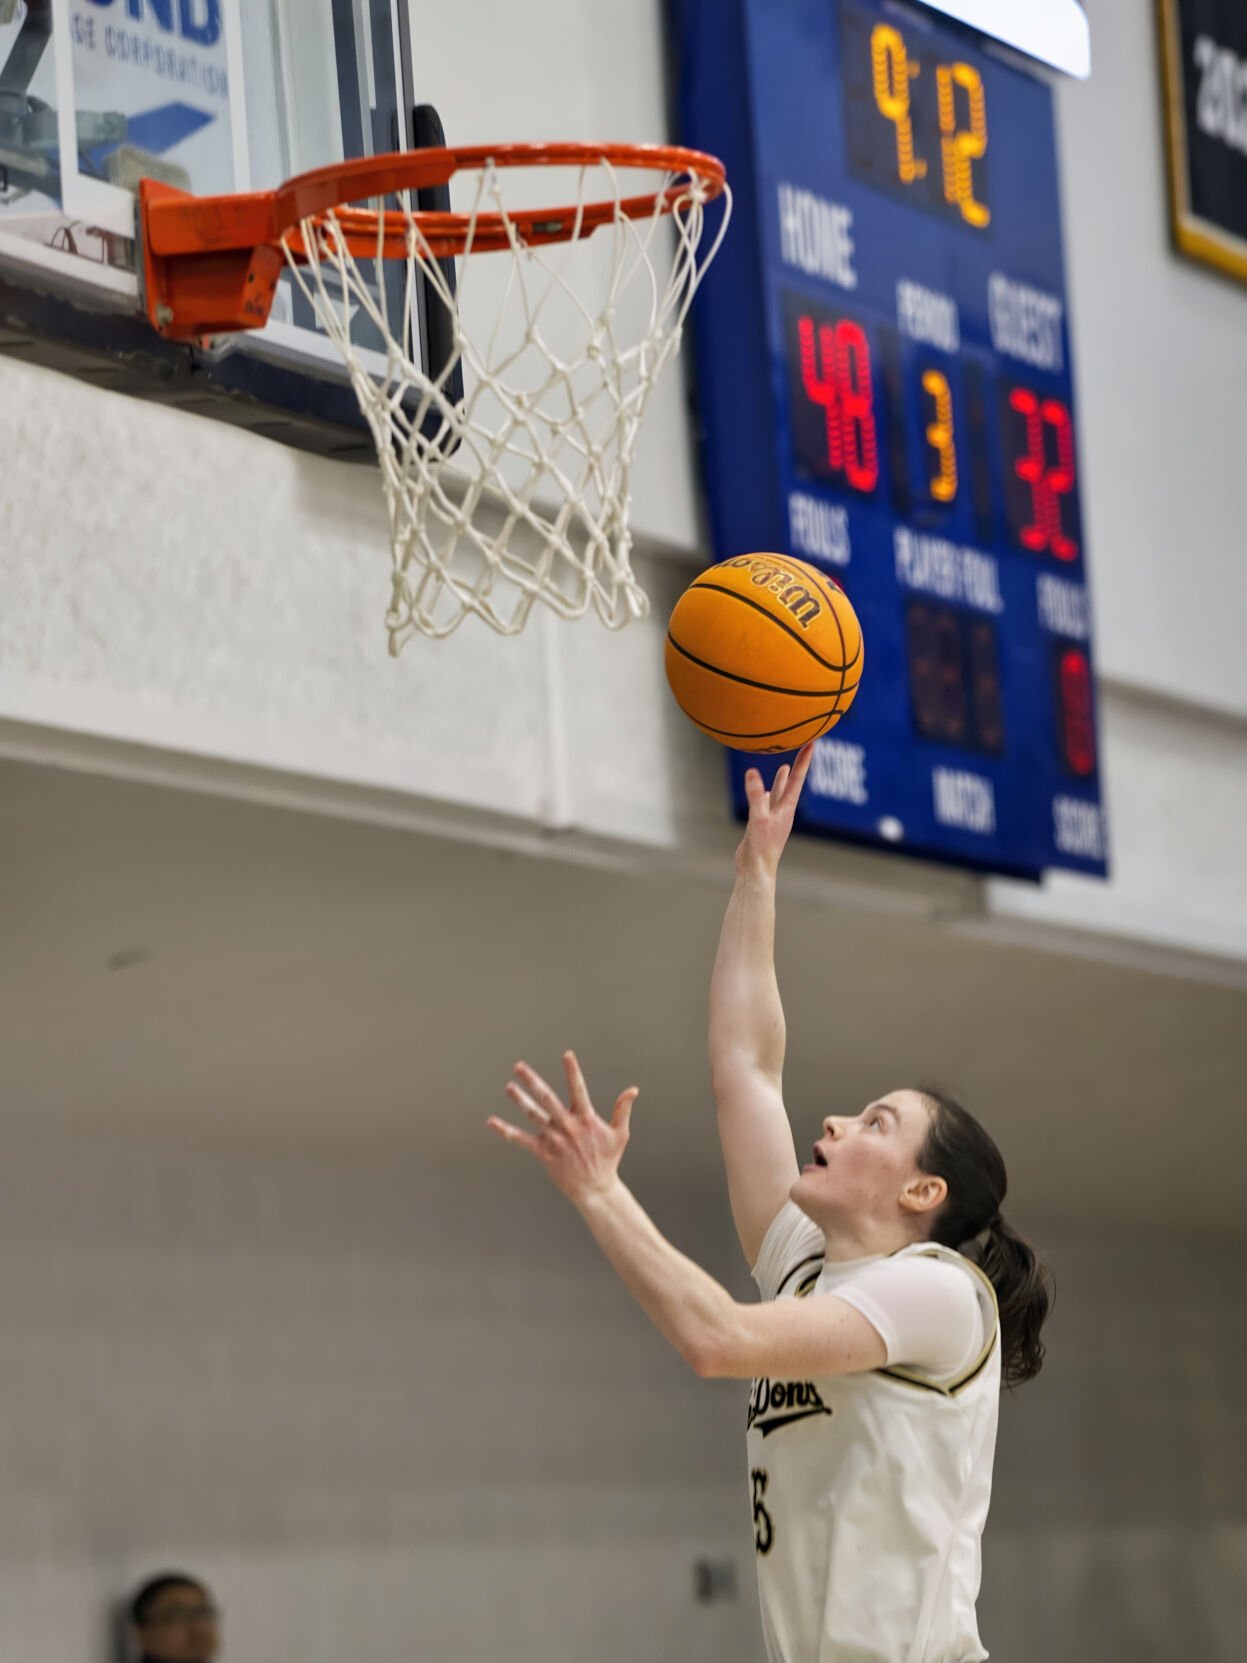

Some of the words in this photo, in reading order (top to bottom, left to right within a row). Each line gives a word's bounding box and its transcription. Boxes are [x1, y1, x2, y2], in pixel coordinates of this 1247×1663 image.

[777, 184, 857, 291] HOME
[798, 316, 878, 493] 48
[922, 368, 958, 502] 3
